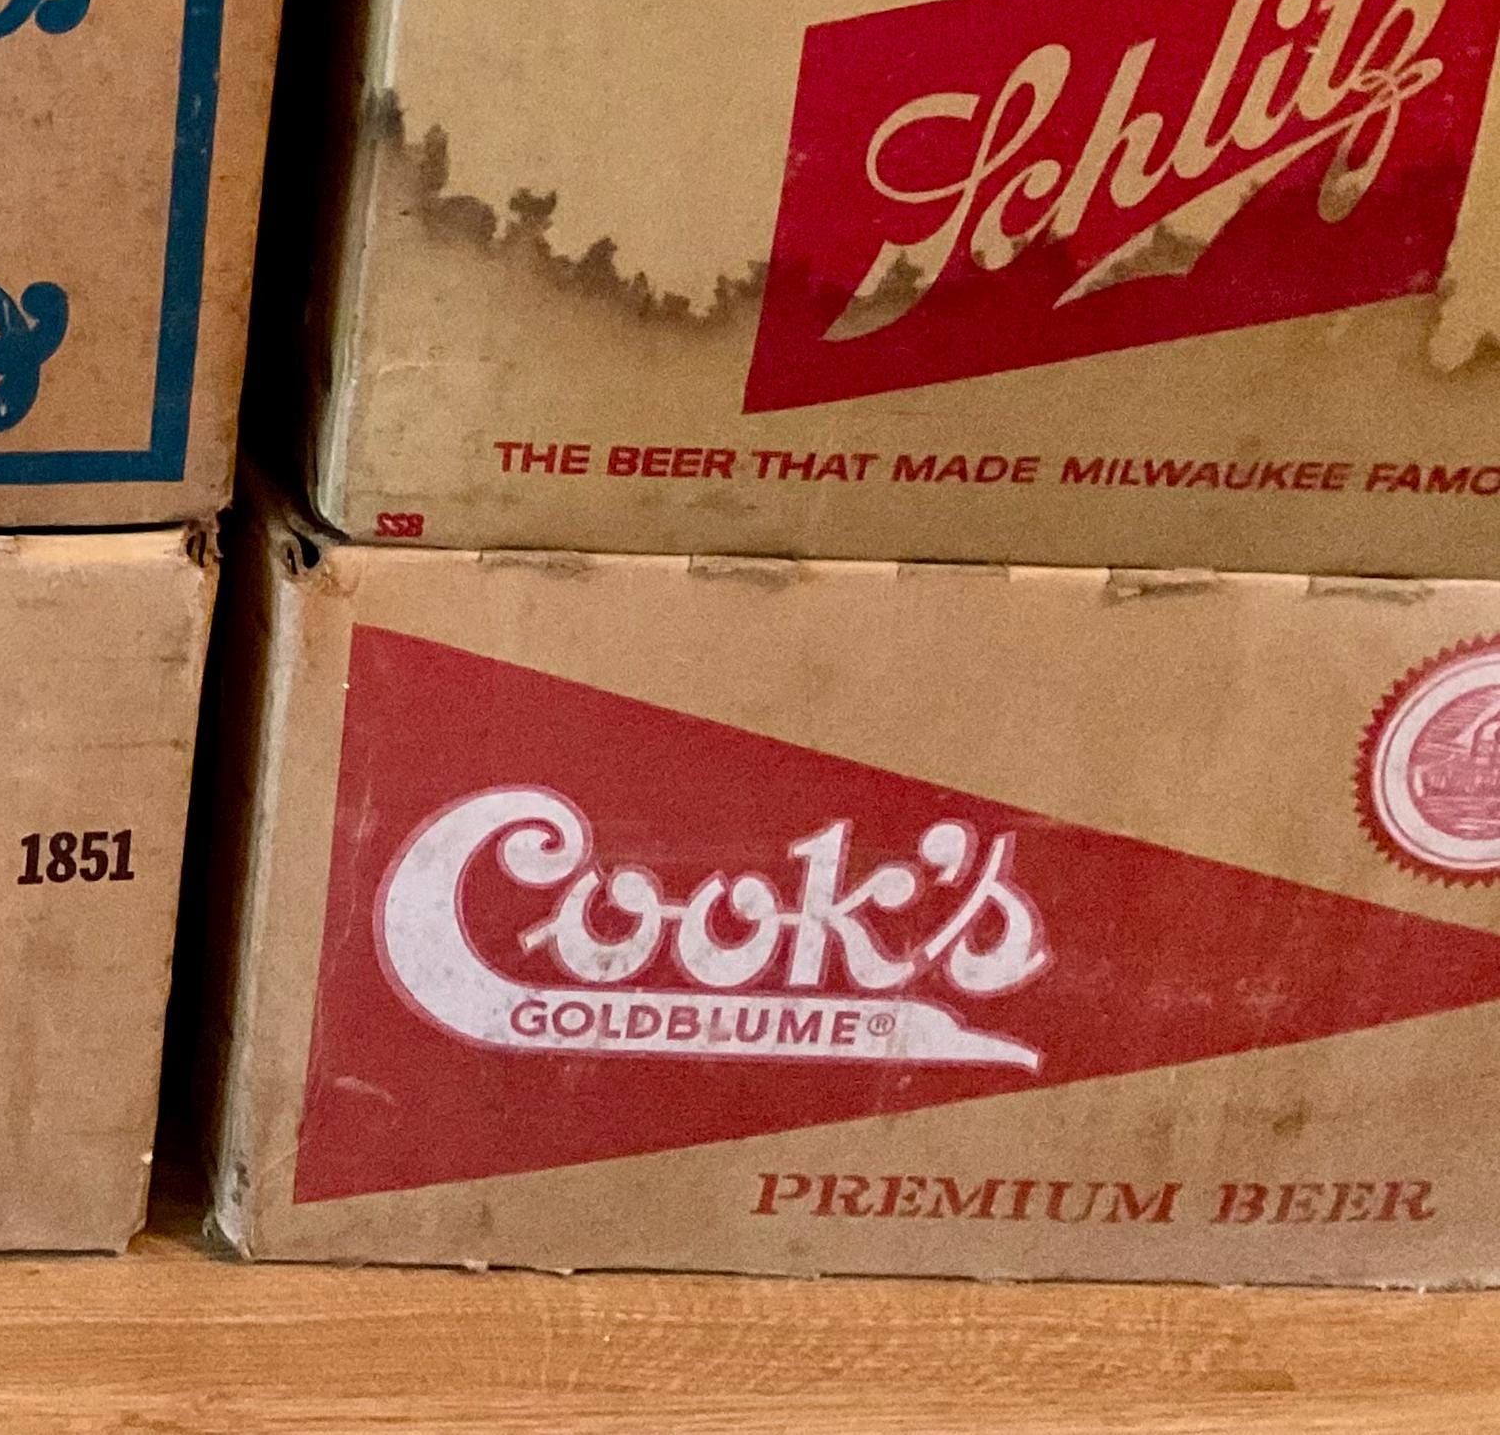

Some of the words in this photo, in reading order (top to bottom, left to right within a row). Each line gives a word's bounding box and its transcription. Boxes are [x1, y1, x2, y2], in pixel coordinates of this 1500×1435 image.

[493, 441, 591, 476] THE
[606, 445, 737, 479] BEER
[750, 450, 880, 482] THAT
[891, 453, 1041, 484] MADE
[1059, 456, 1357, 493] MILWAUKEE
[1364, 462, 1500, 496] FAMO
[17, 829, 134, 885] 1851
[374, 783, 1054, 1071] Cook's
[750, 1172, 1184, 1225] PREMIUM
[1209, 1178, 1436, 1226] BEER
